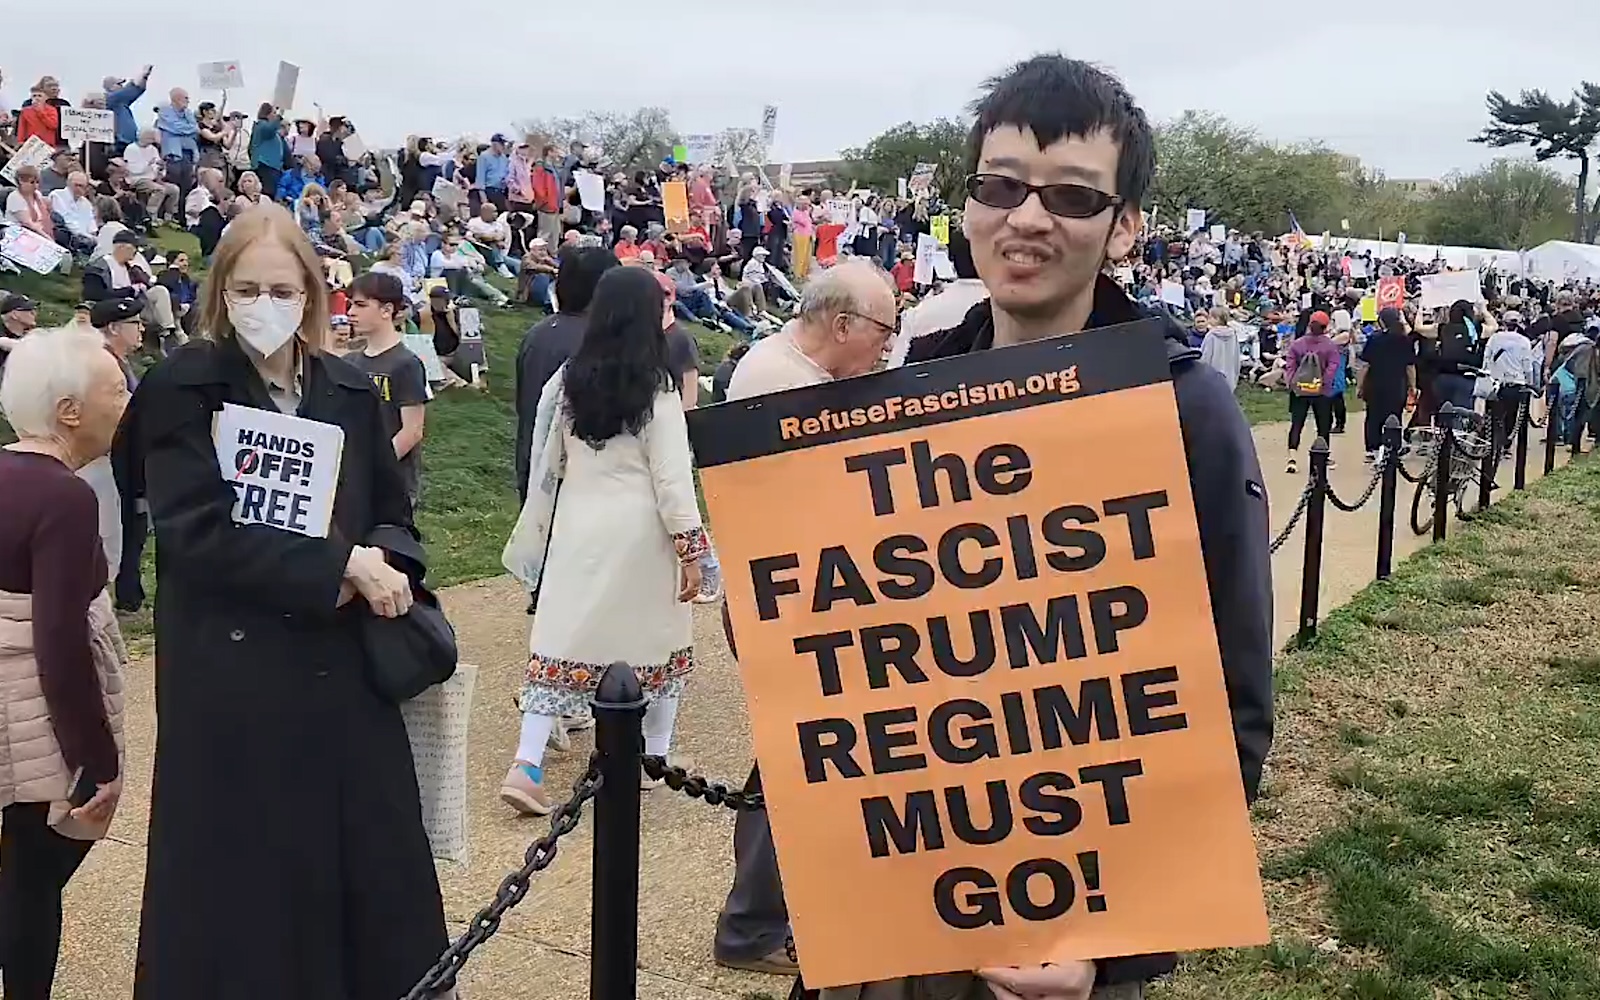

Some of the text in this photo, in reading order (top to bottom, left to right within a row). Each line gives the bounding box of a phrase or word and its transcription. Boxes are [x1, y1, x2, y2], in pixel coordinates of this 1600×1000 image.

[779, 364, 1081, 440] RefuseFascism.org
[234, 448, 313, 487] OFF!
[237, 428, 315, 458] HANDS
[844, 439, 1033, 517] The
[748, 489, 1170, 622] FASCIST
[792, 585, 1149, 697] TRUMP
[796, 665, 1189, 784] REGIME
[860, 758, 1144, 859] MUST
[932, 849, 1108, 930] GO!
